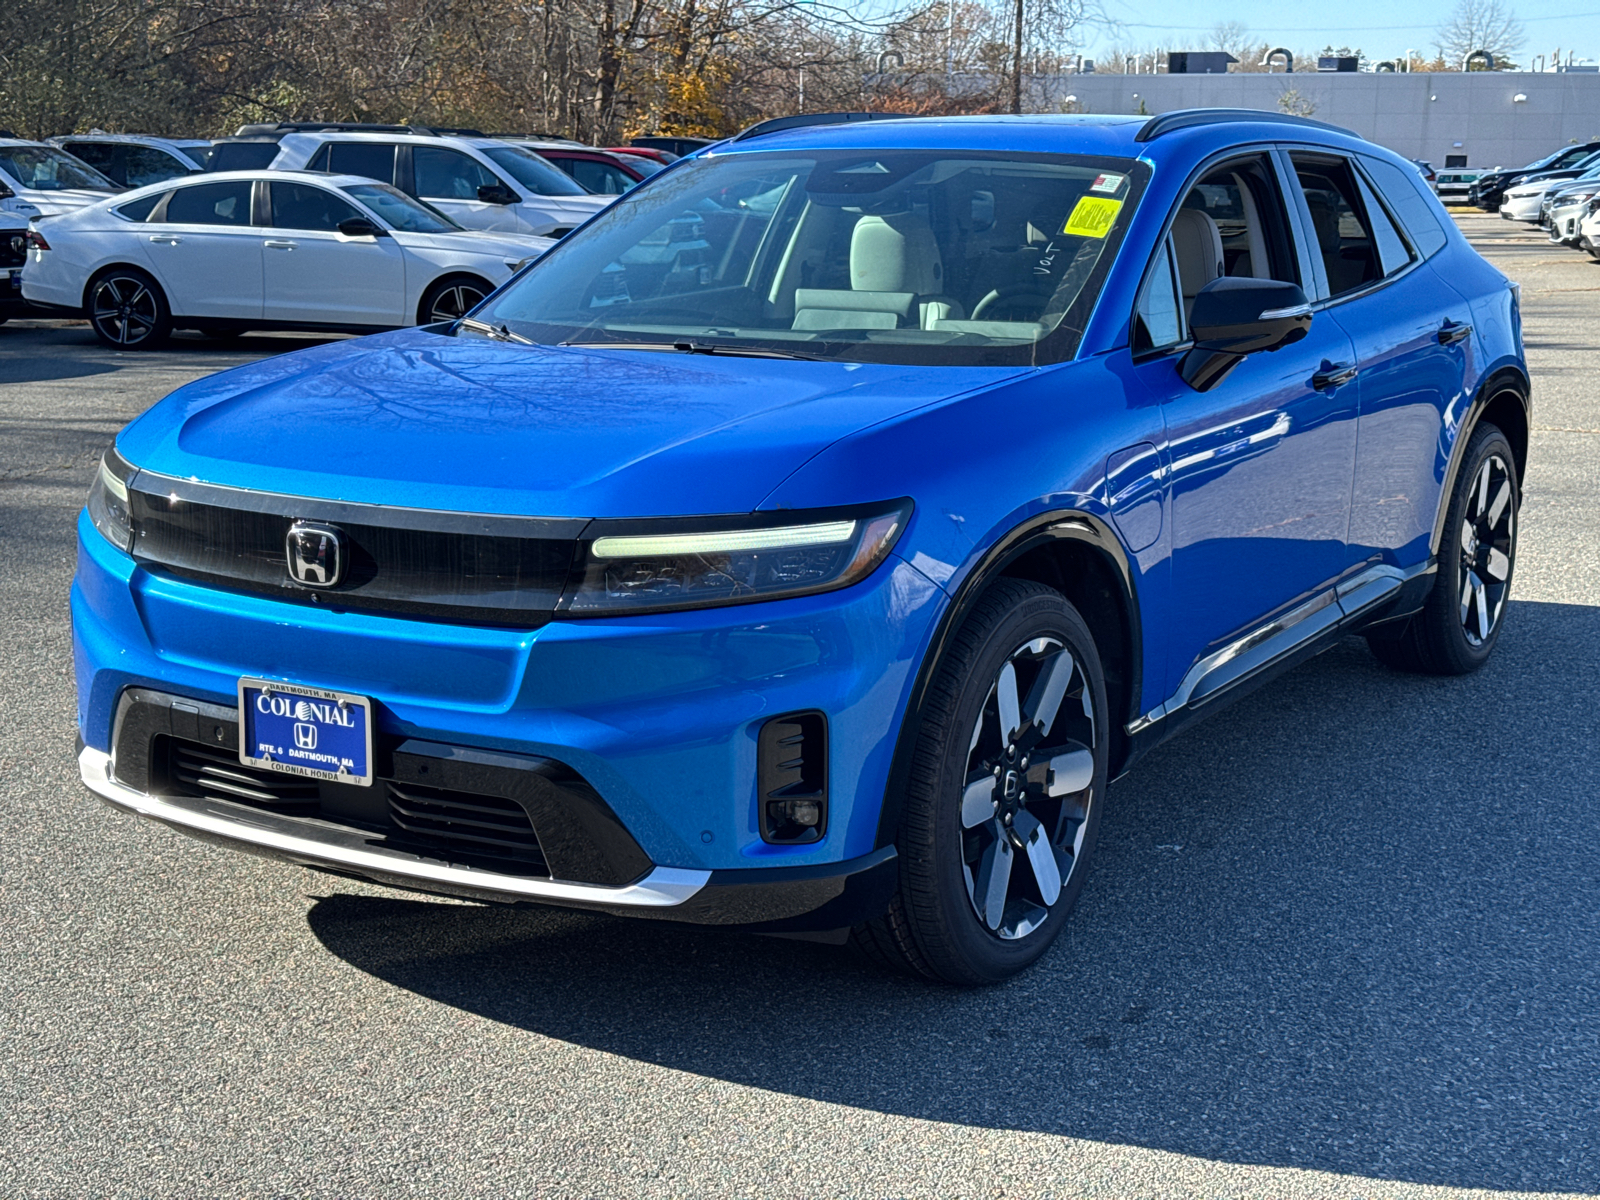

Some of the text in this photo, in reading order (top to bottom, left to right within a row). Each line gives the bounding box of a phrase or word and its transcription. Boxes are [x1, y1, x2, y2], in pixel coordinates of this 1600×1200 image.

[324, 692, 337, 700] MA
[256, 695, 355, 728] COLONIAL
[278, 747, 283, 755] 6
[289, 748, 340, 766] DARTMOUTH,
[341, 758, 354, 768] MA
[271, 762, 339, 781] COLONIAL HONDA
